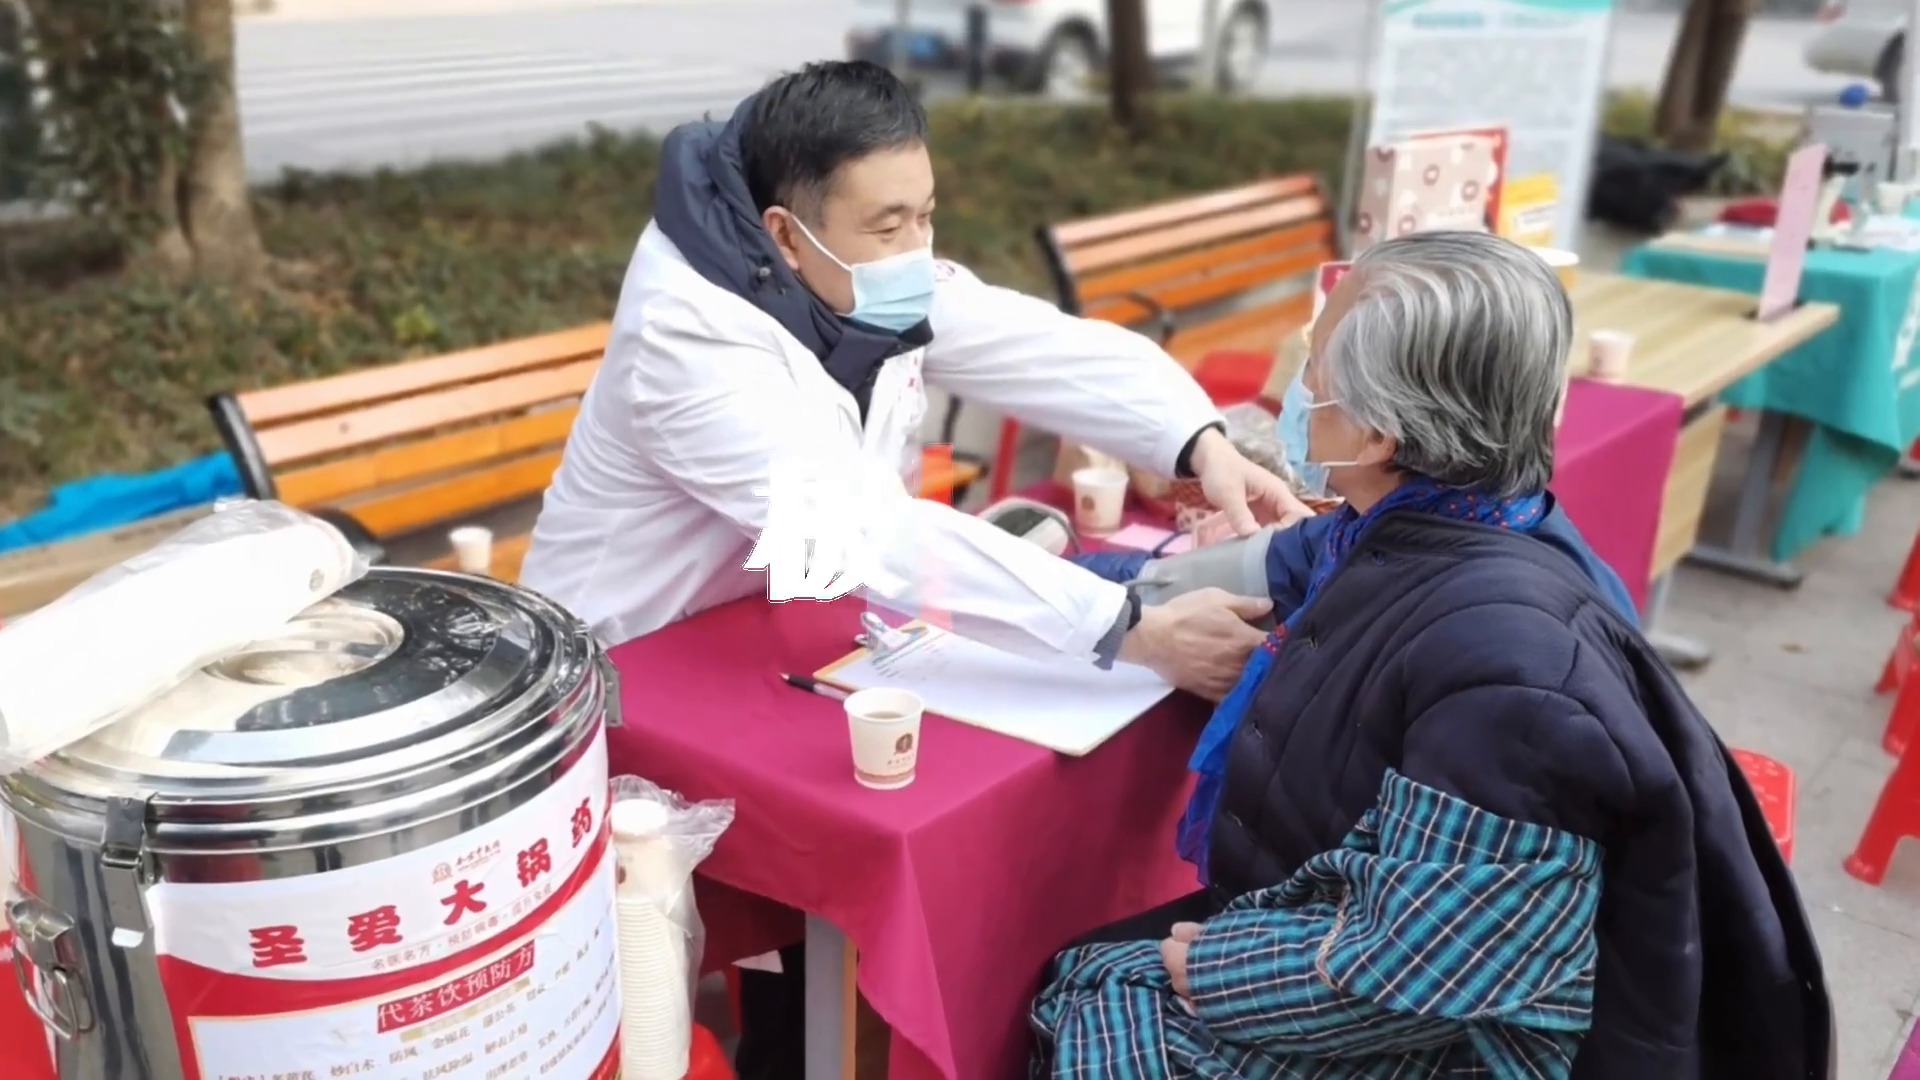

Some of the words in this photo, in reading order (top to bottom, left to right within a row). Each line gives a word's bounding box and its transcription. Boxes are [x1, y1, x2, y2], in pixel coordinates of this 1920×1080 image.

[249, 797, 592, 968] 圣爱大锅药
[379, 950, 532, 1028] 代茶饮预防方
